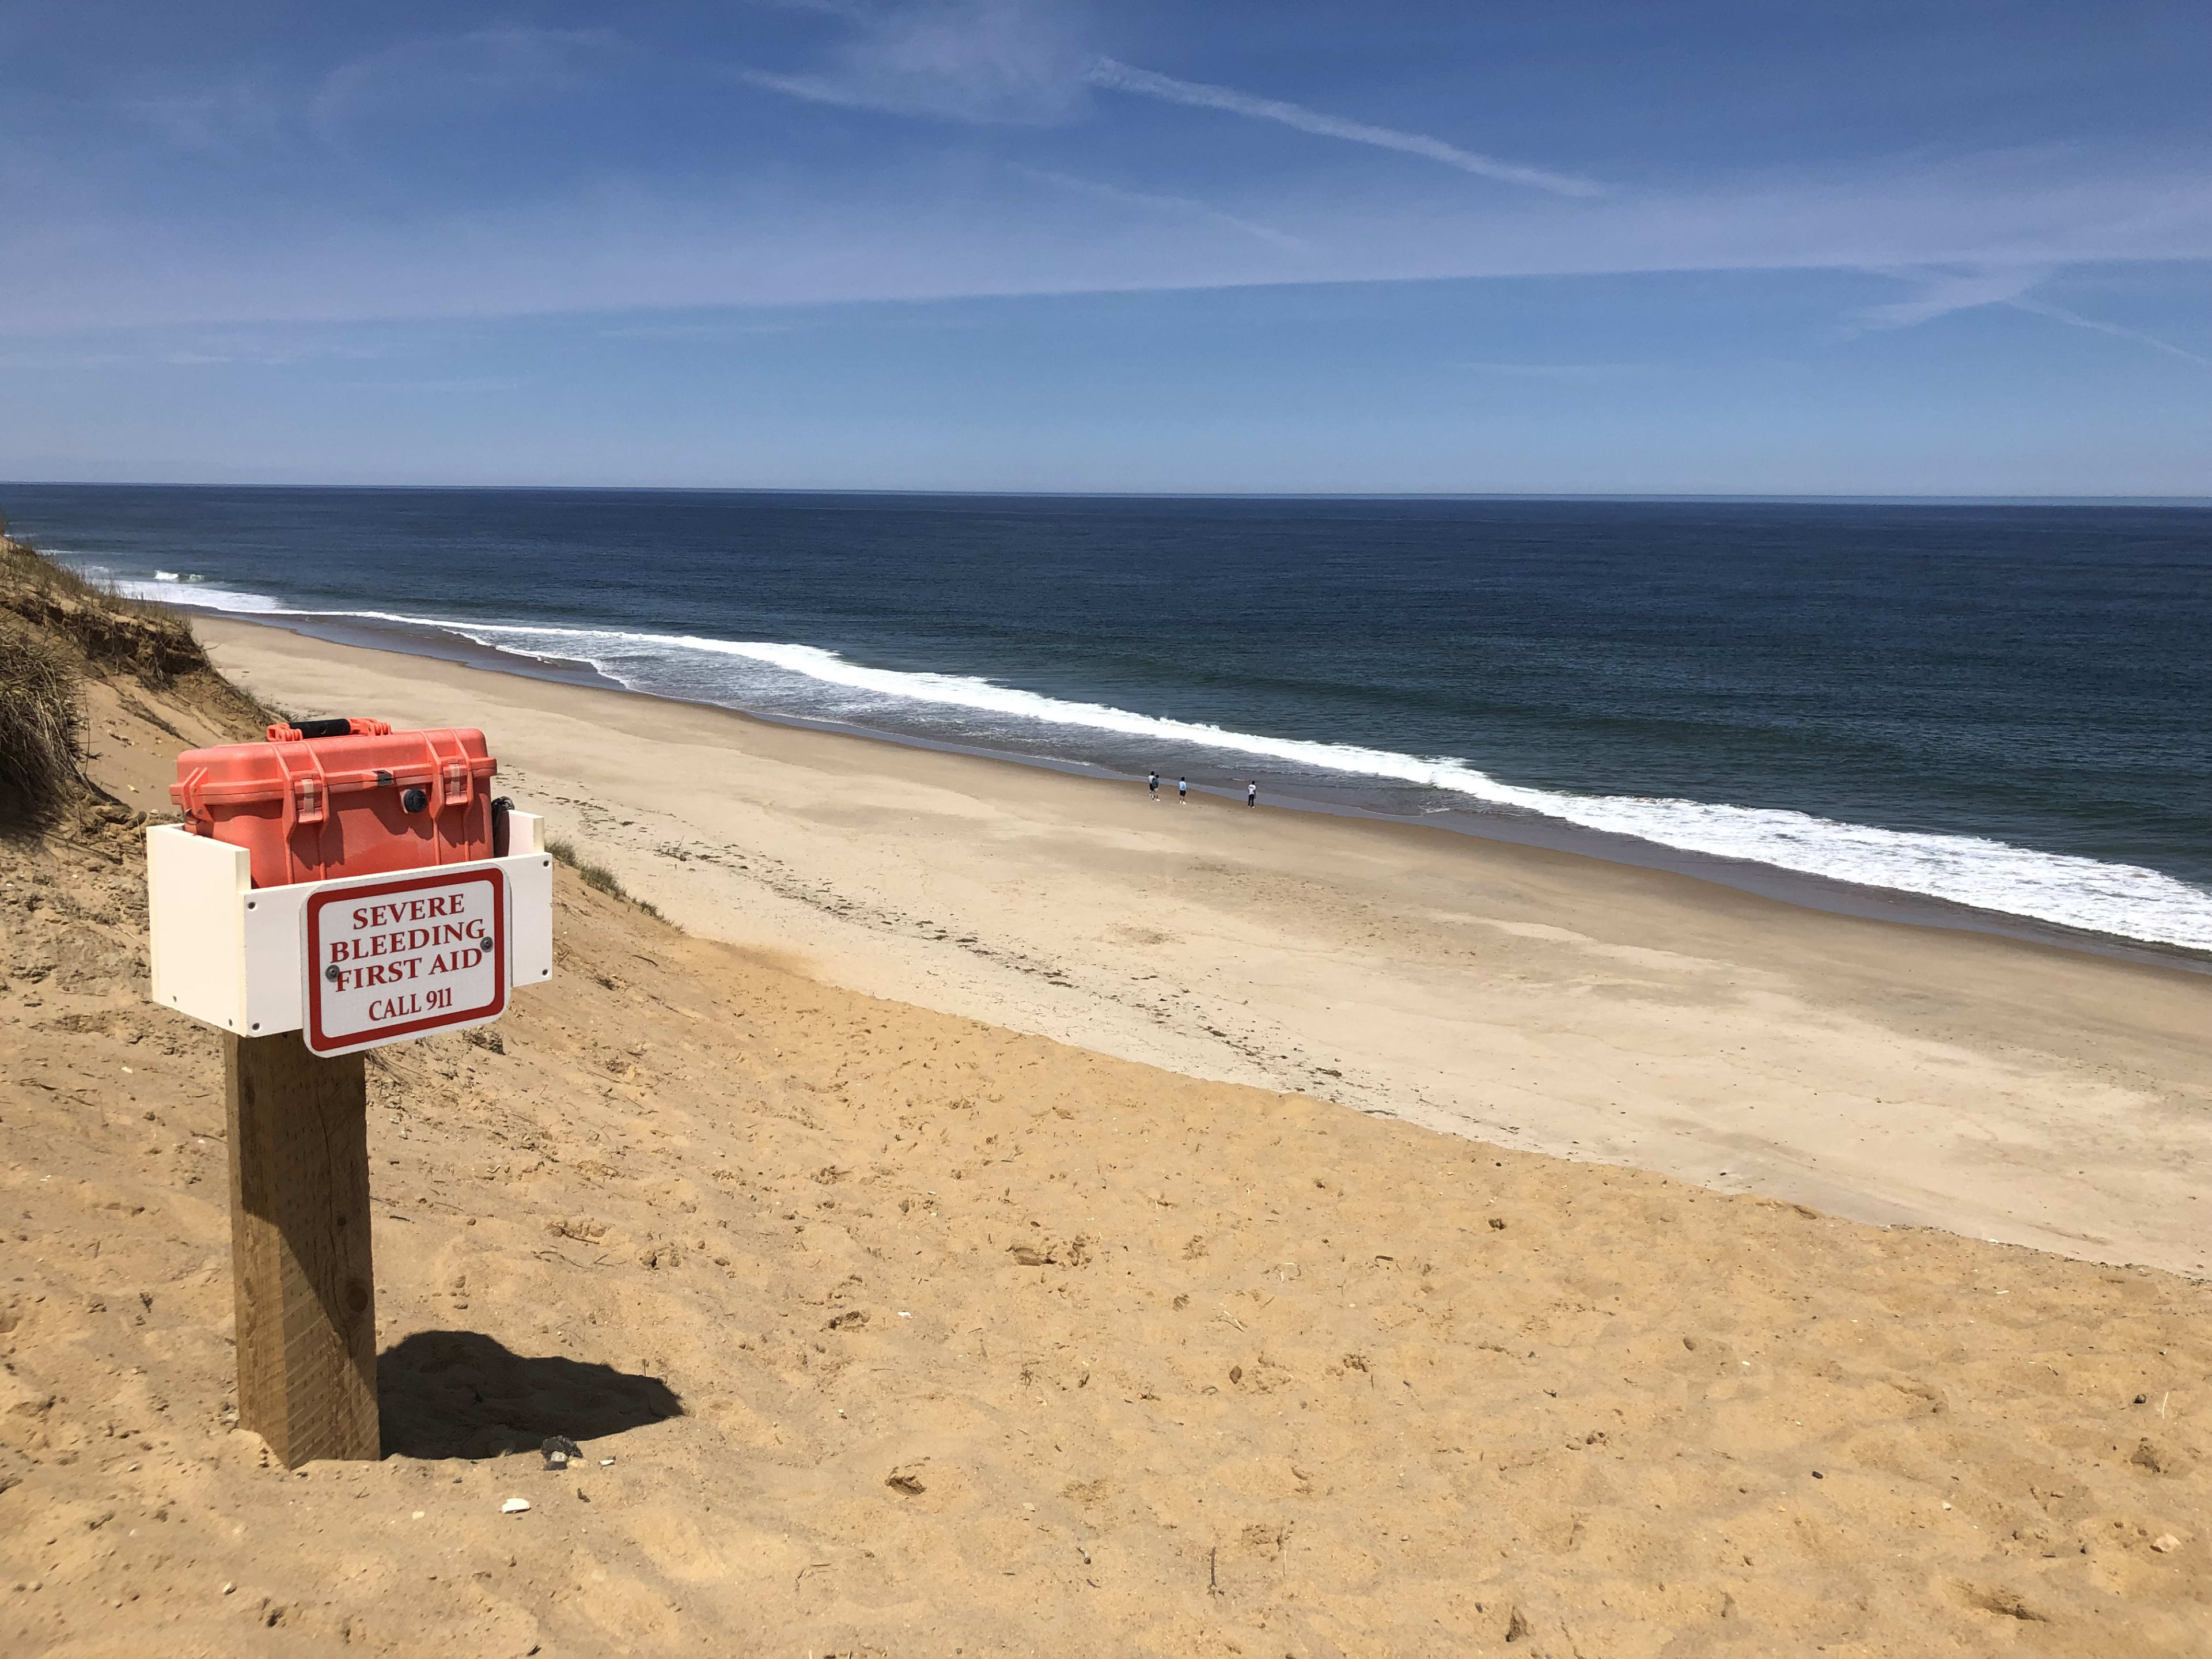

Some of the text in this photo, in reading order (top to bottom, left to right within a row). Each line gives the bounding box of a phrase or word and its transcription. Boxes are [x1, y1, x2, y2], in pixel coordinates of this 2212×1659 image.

[353, 893, 464, 930] SEVERE
[329, 919, 486, 963] BLEEDING
[335, 948, 482, 993] FIRST AID
[369, 987, 452, 1021] CALL 911
